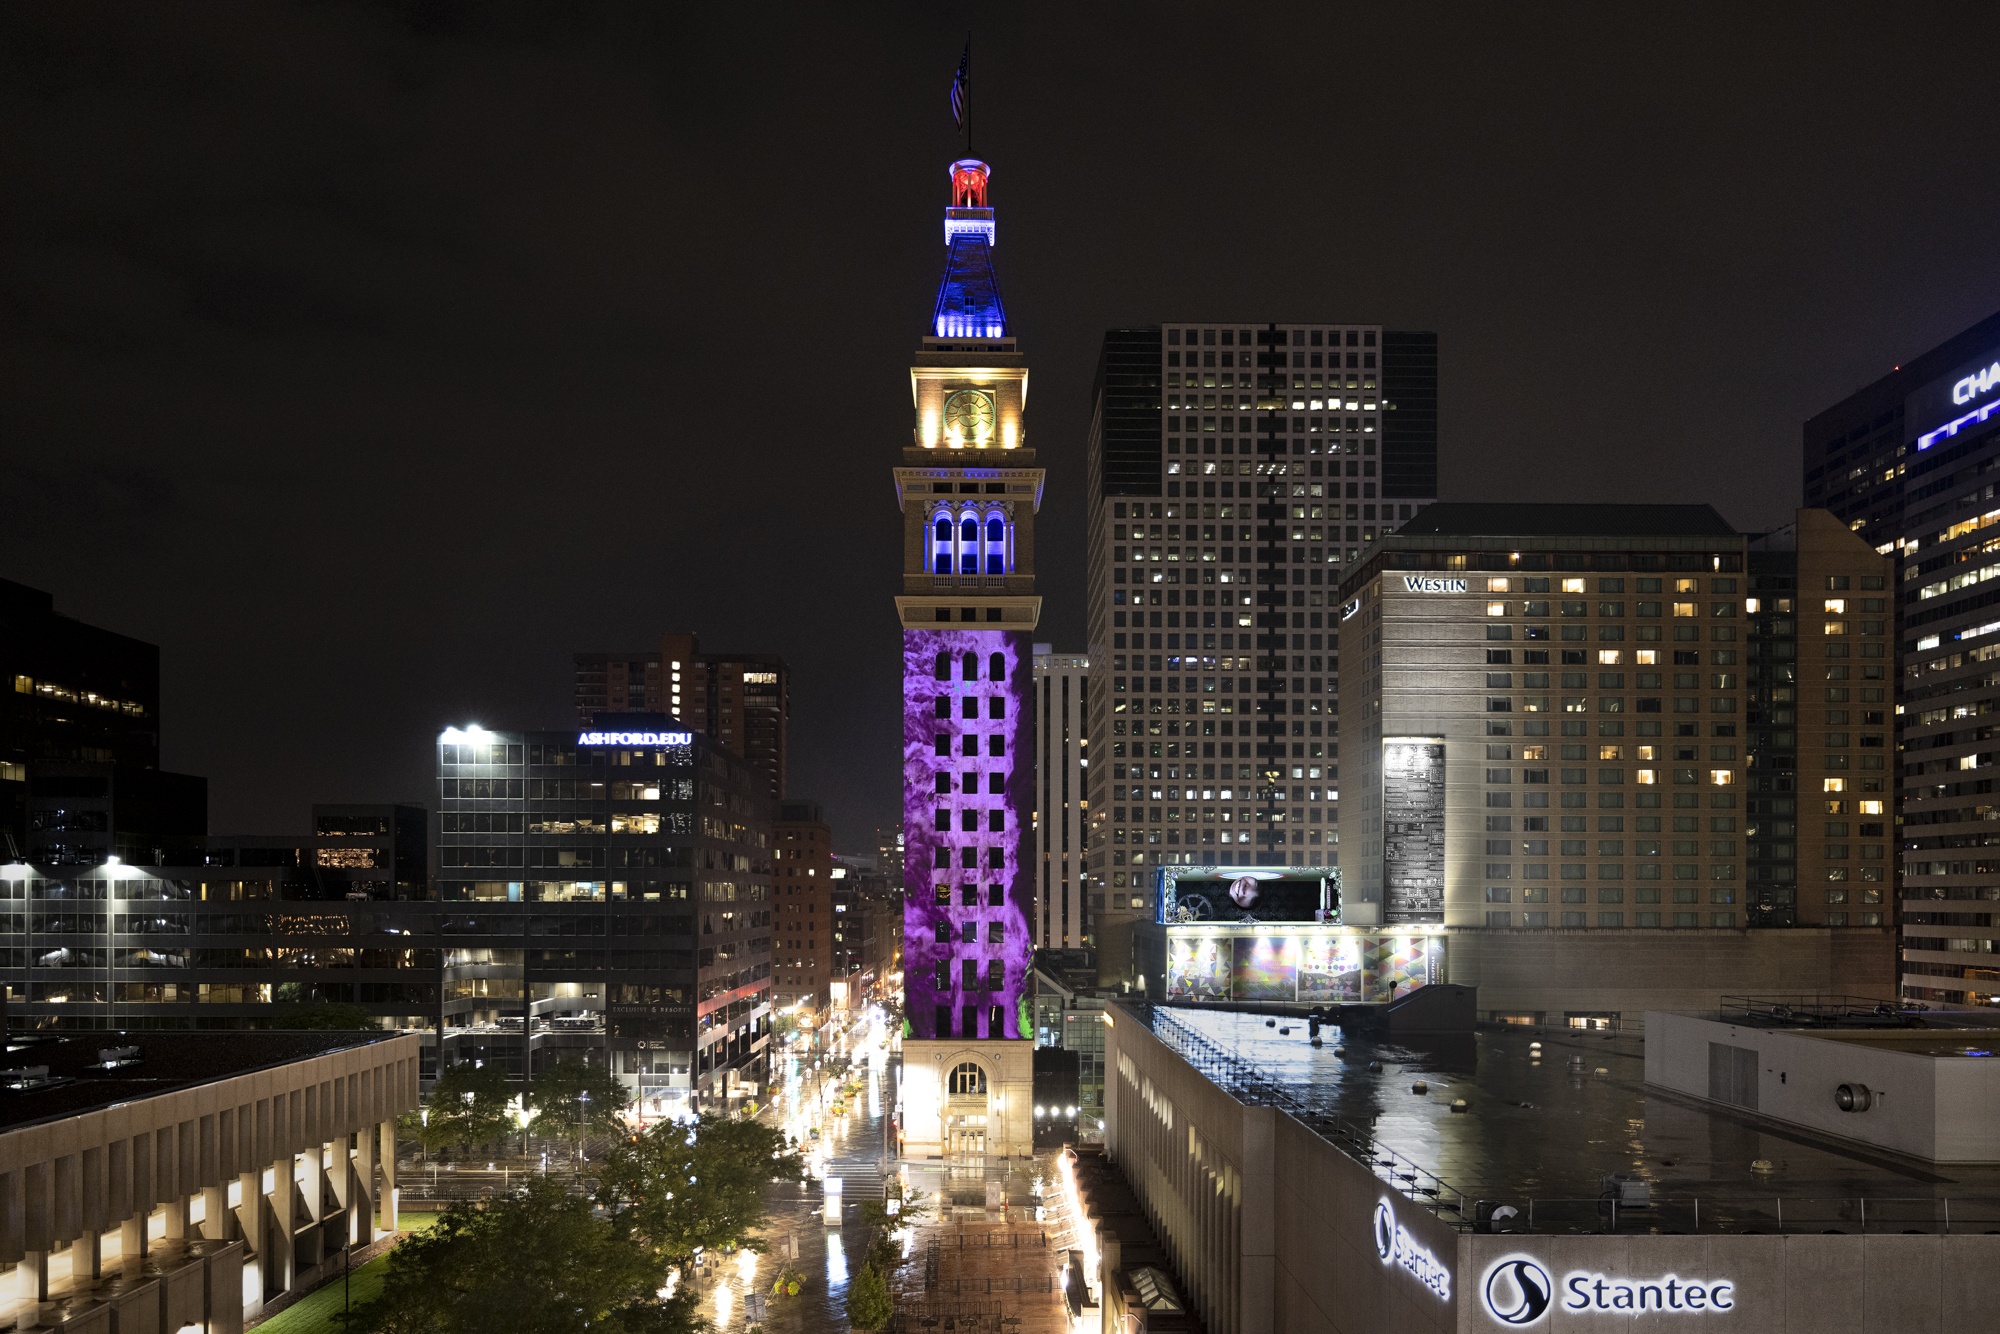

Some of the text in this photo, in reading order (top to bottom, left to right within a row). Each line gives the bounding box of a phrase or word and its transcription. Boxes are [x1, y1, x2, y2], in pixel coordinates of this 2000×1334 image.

[578, 732, 693, 745] ASHFORD.EDU
[1394, 1228, 1448, 1298] Stantec
[1567, 1276, 1734, 1310] Stantec
